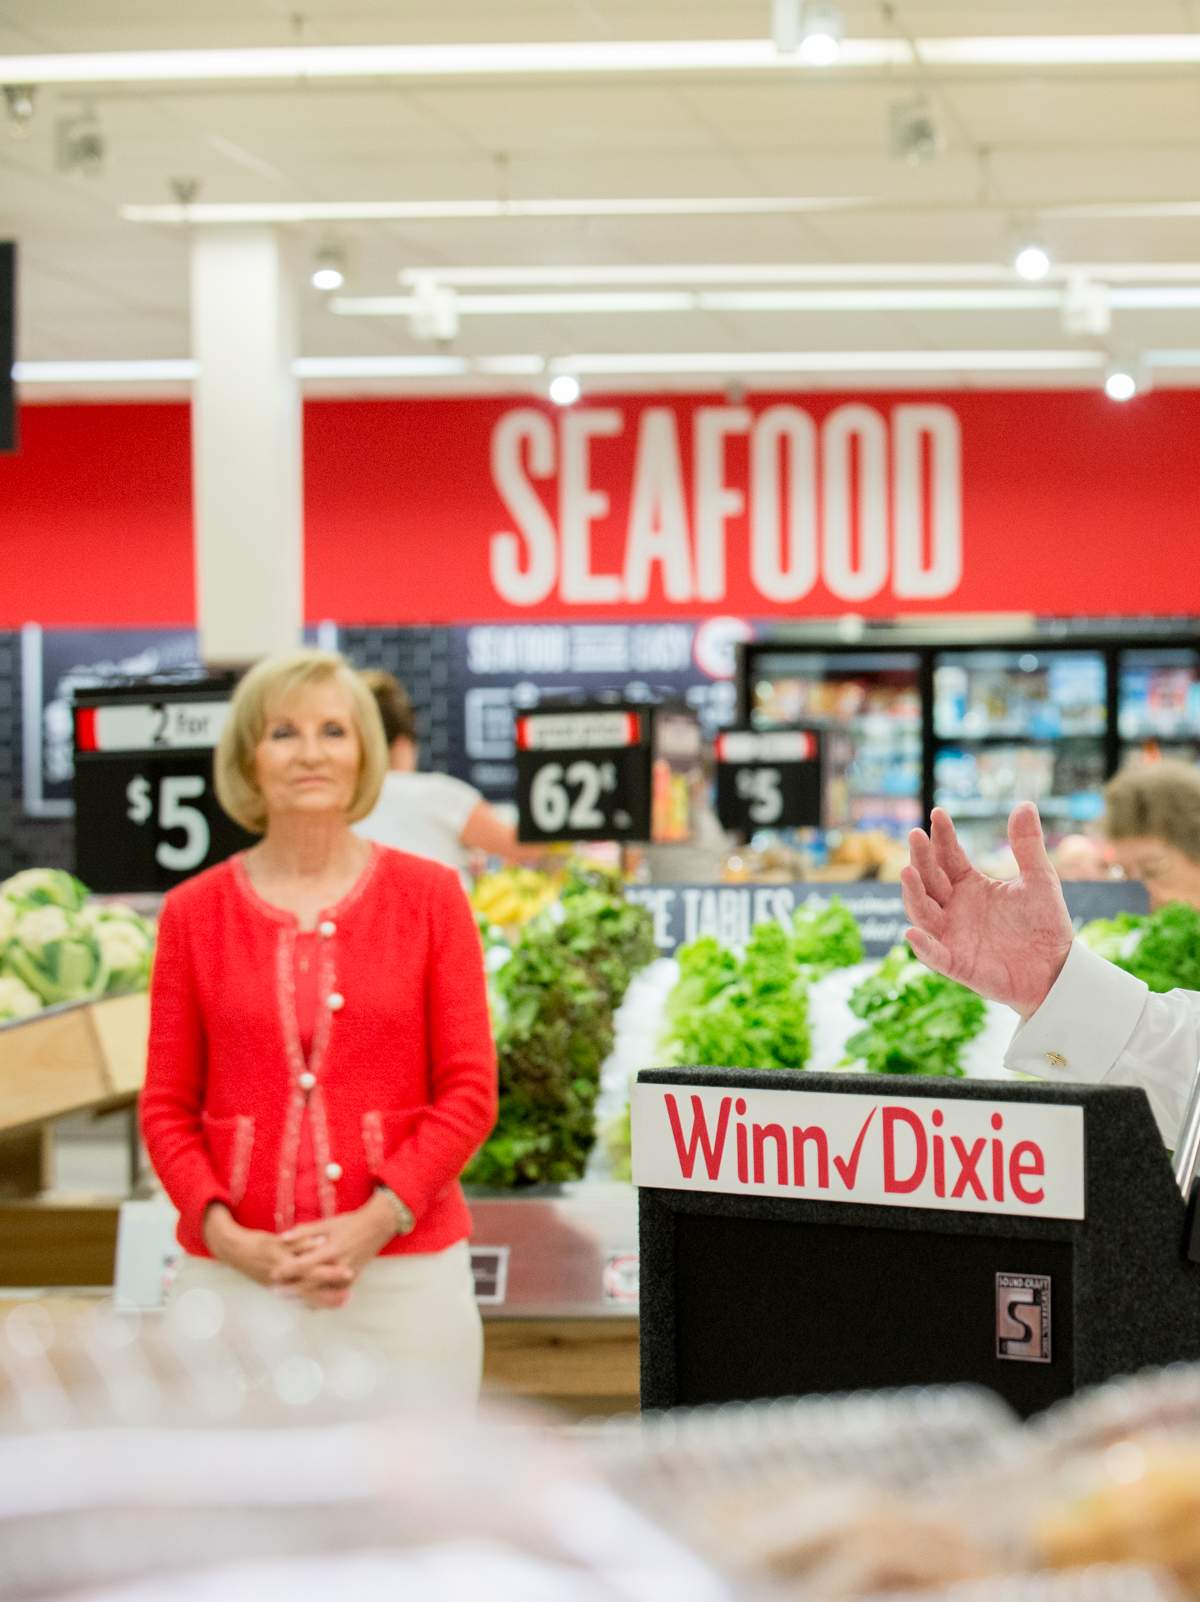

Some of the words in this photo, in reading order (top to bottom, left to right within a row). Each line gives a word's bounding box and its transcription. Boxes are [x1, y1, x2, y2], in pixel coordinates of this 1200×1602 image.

[489, 402, 962, 606] SEAFOOD
[151, 701, 171, 747] 2
[126, 774, 210, 871] $5
[664, 1093, 829, 1189] Winn
[881, 1105, 1046, 1205] Dixie
